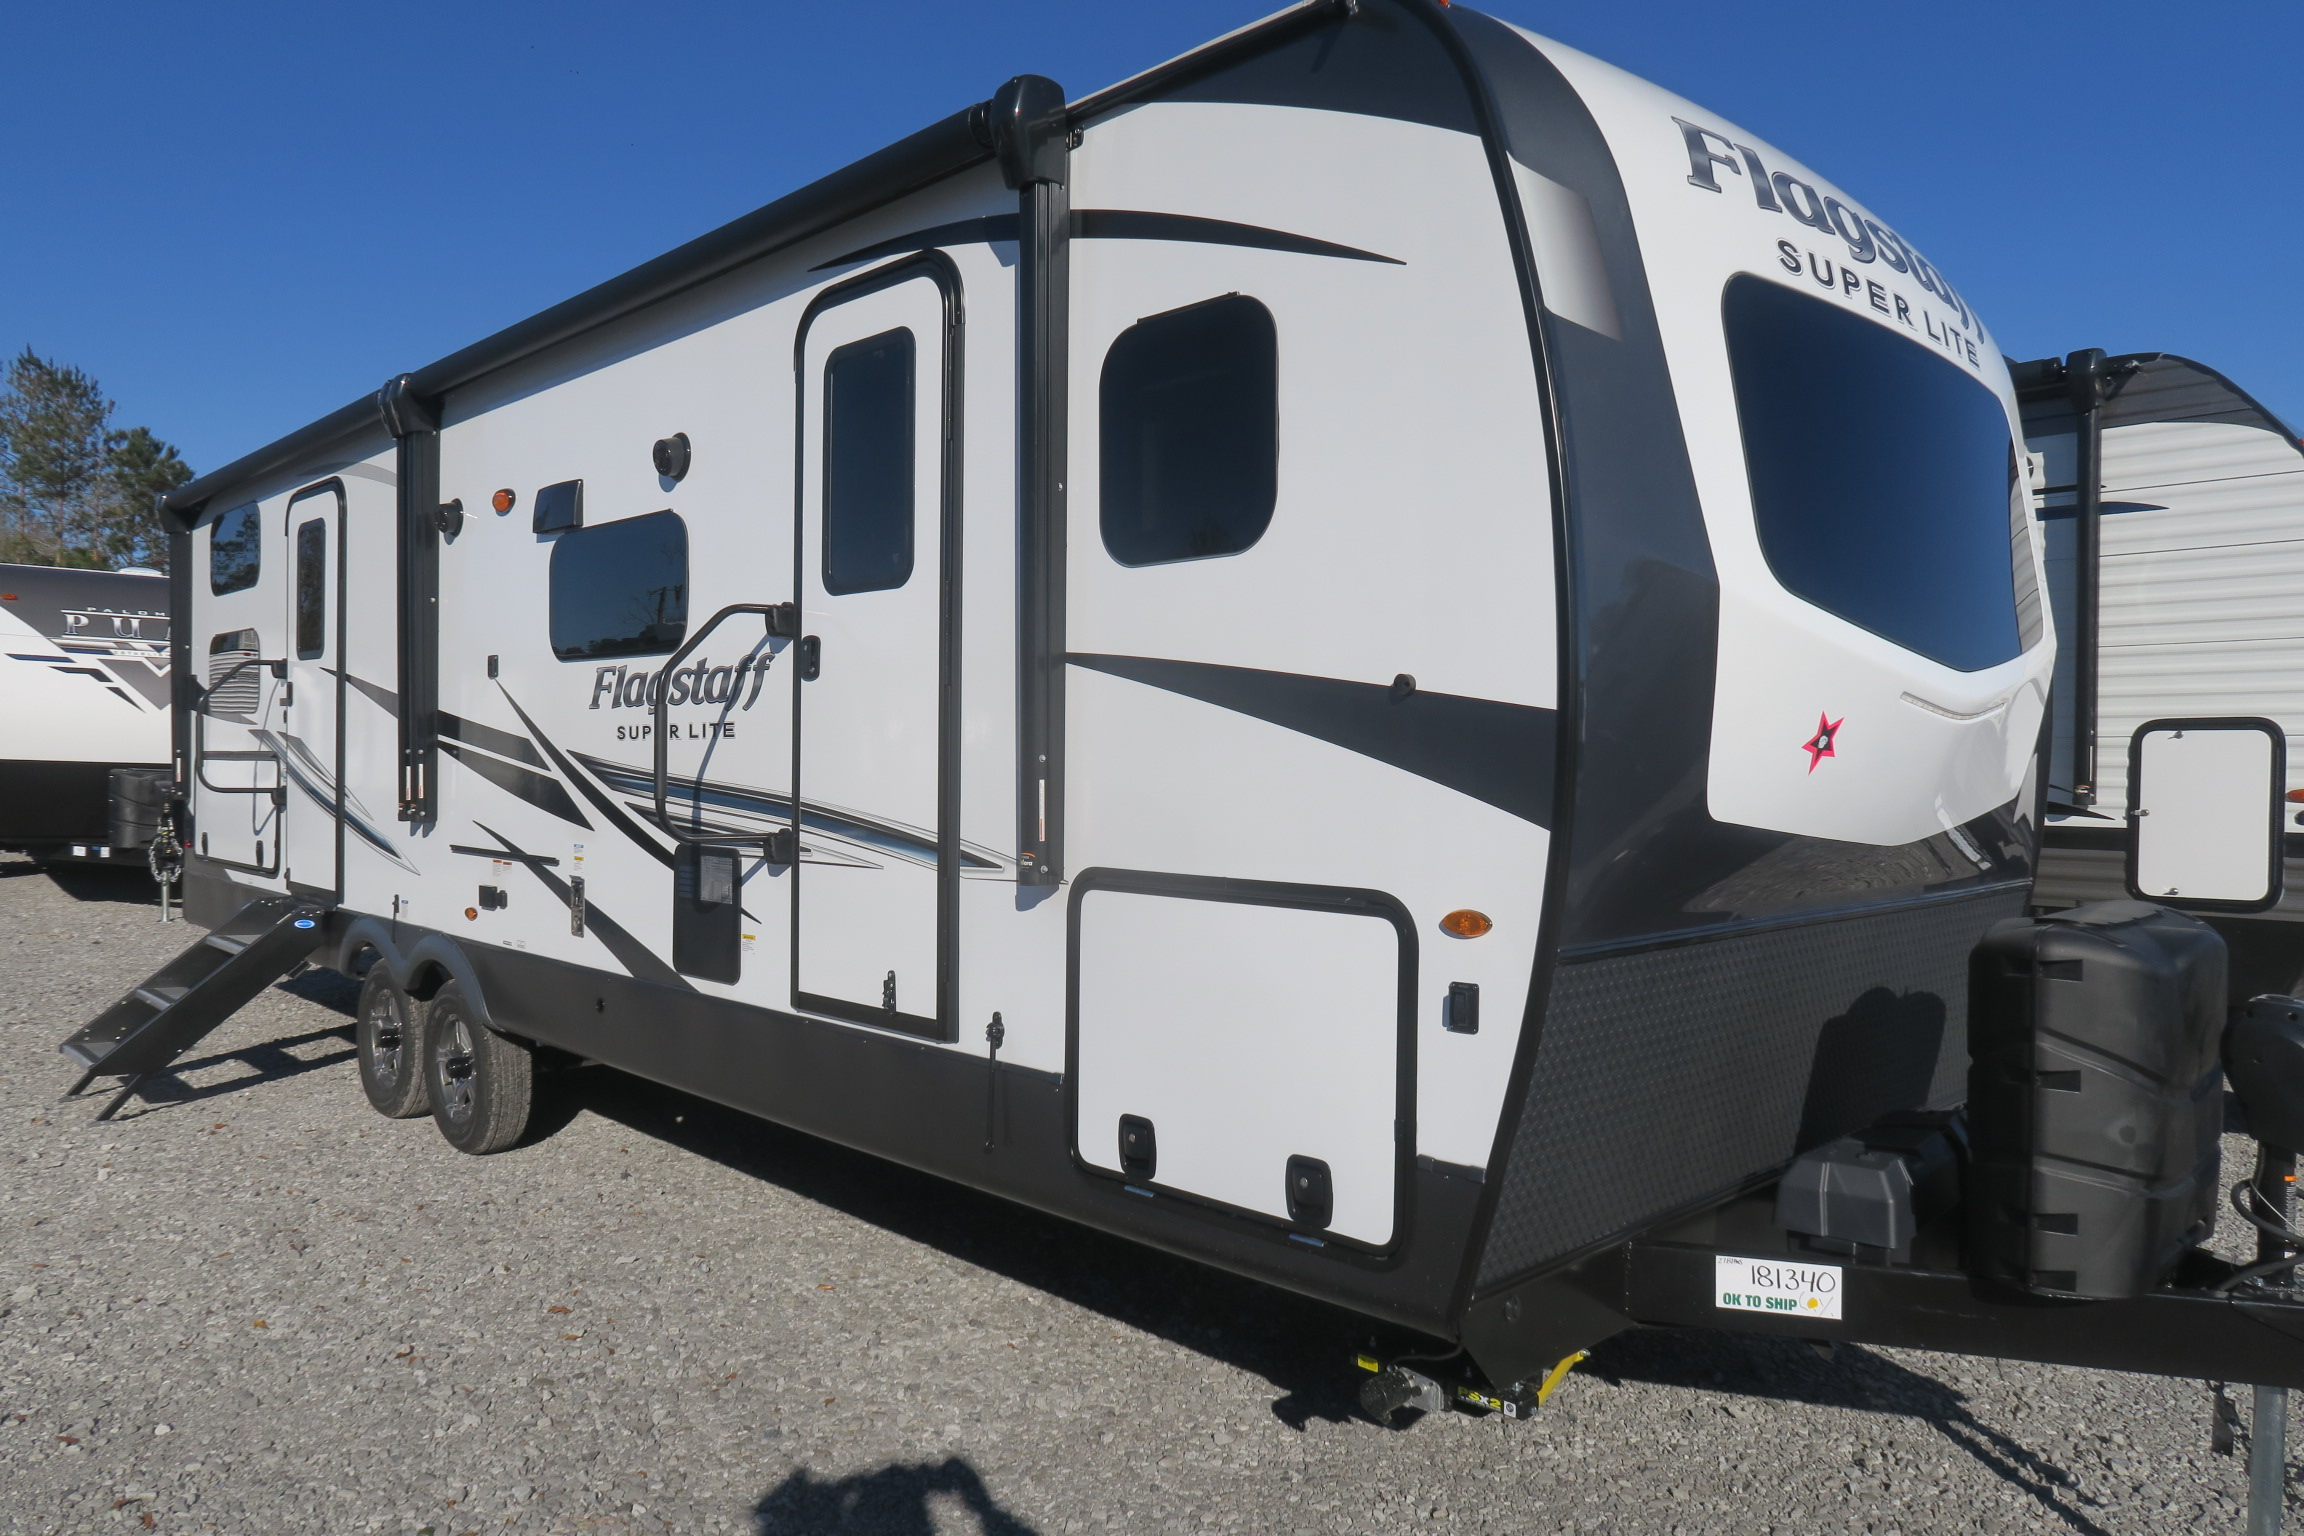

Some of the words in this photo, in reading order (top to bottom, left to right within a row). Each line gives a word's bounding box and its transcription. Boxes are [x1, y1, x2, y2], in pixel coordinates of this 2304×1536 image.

[1776, 237, 1916, 332] SUPER
[1923, 307, 1982, 372] LITE
[616, 723, 681, 741] SUPR
[689, 720, 736, 740] LITE
[1751, 1264, 1836, 1293] 181340
[1722, 1292, 1742, 1306] OK
[1745, 1294, 1762, 1308] TO
[1765, 1296, 1798, 1311] SHIP
